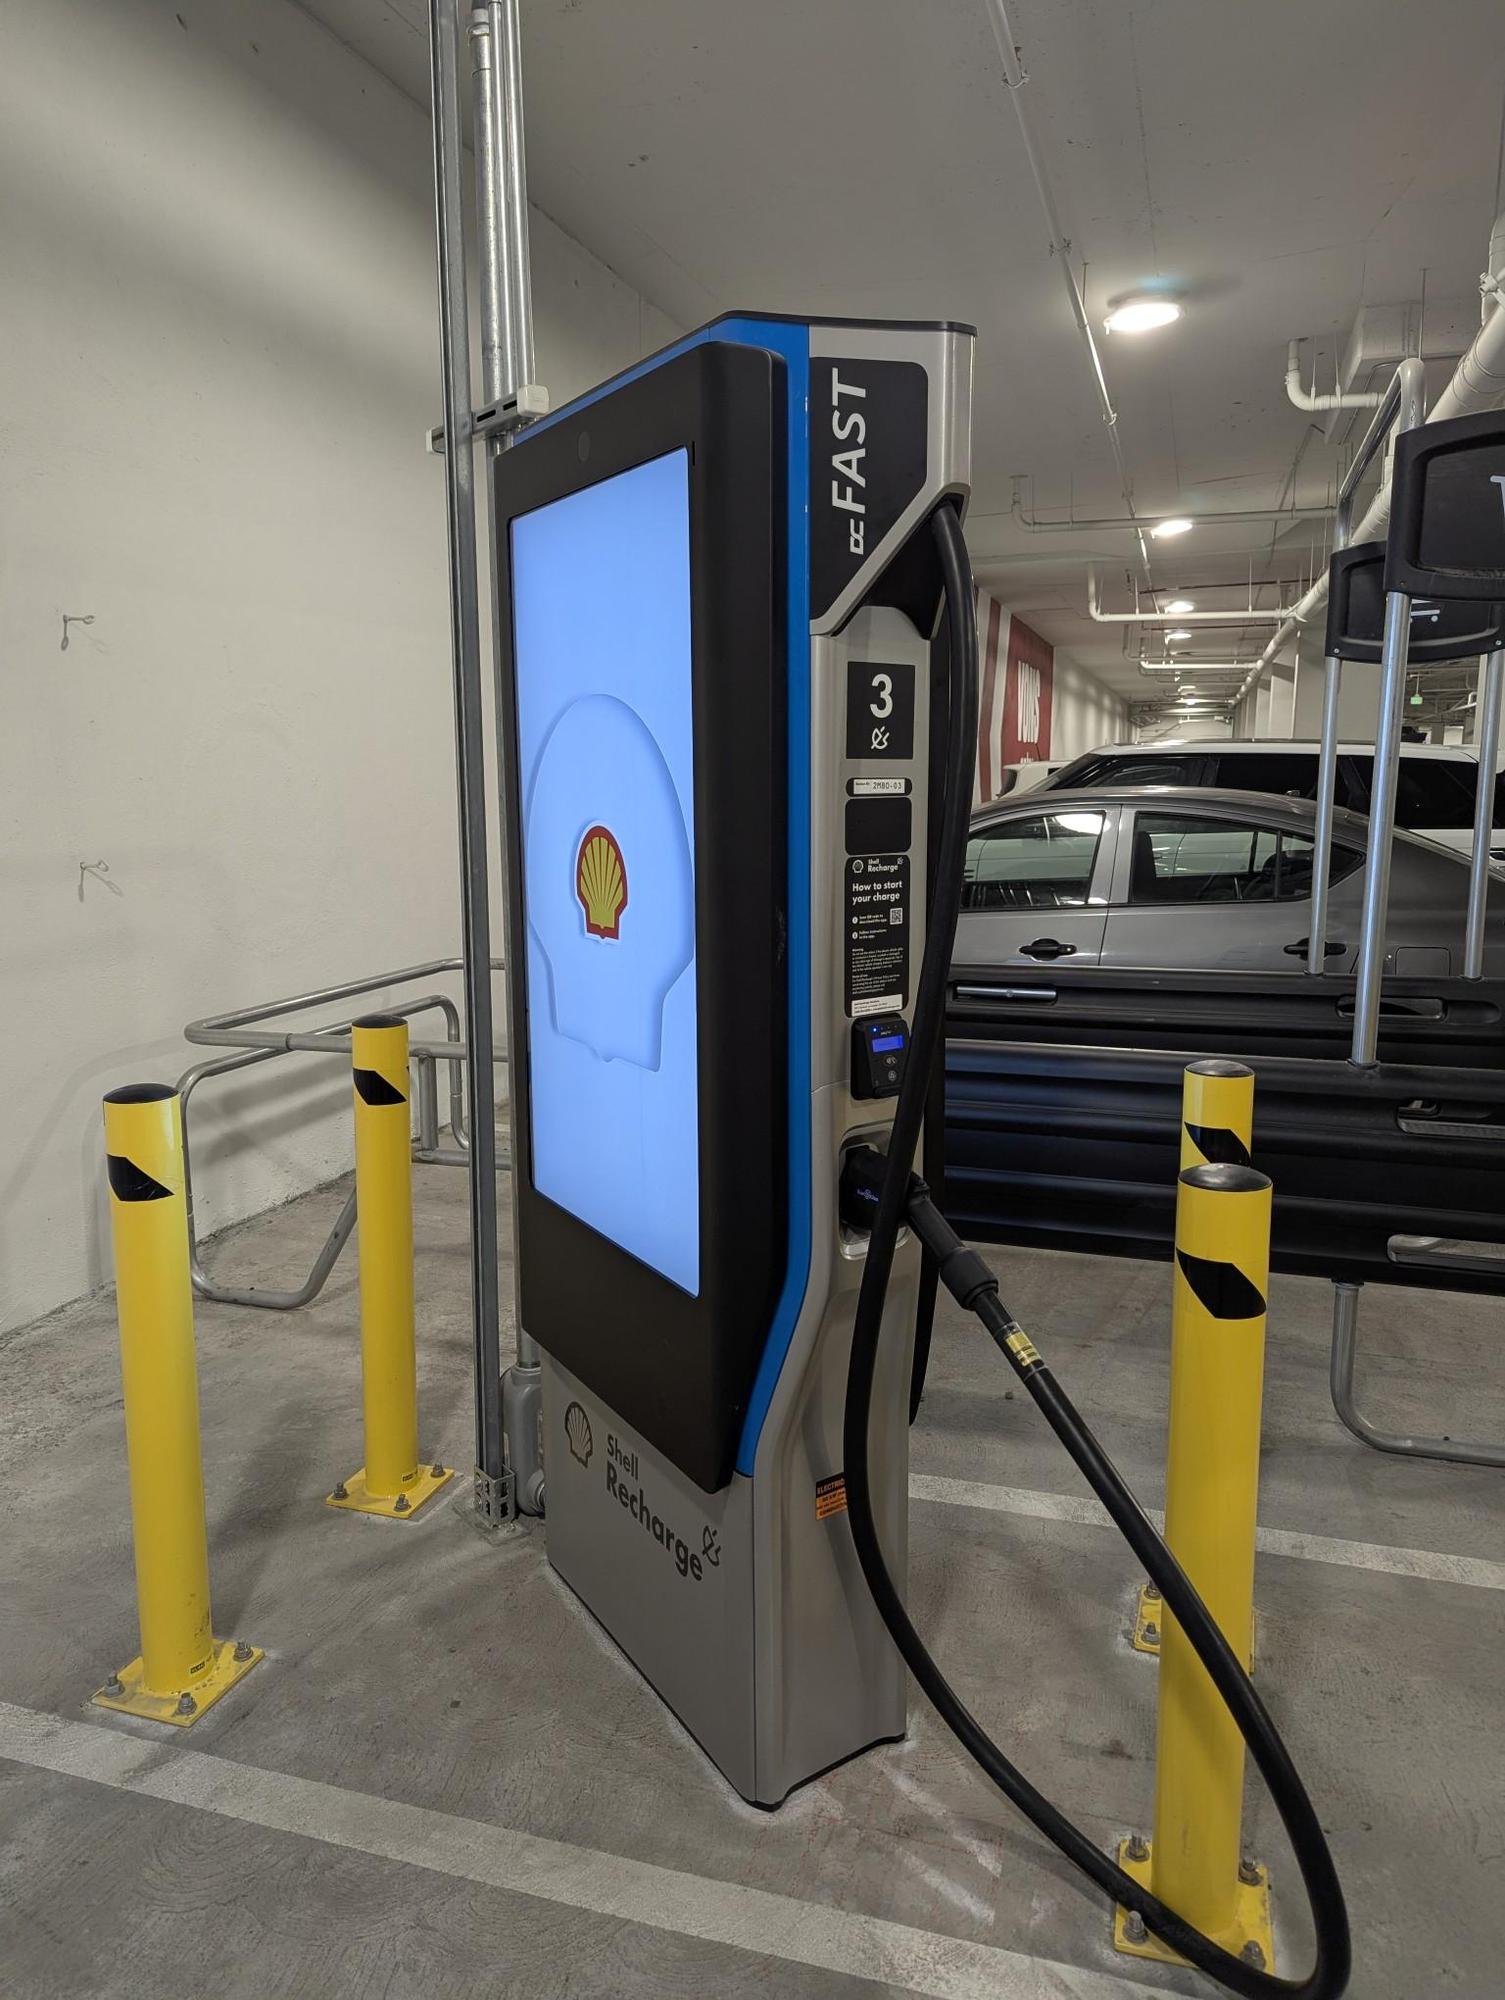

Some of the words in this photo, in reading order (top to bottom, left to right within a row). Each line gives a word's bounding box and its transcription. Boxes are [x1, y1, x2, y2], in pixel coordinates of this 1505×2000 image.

[831, 367, 867, 514] FAST
[849, 520, 864, 555] DC
[869, 673, 893, 719] 3
[852, 882, 871, 892] How
[873, 882, 882, 890] to
[883, 880, 902, 889] start
[867, 864, 898, 872] Recharge
[852, 895, 871, 905] your
[872, 892, 900, 902] charge
[607, 1433, 639, 1481] Shell
[606, 1462, 703, 1581] Recharge
